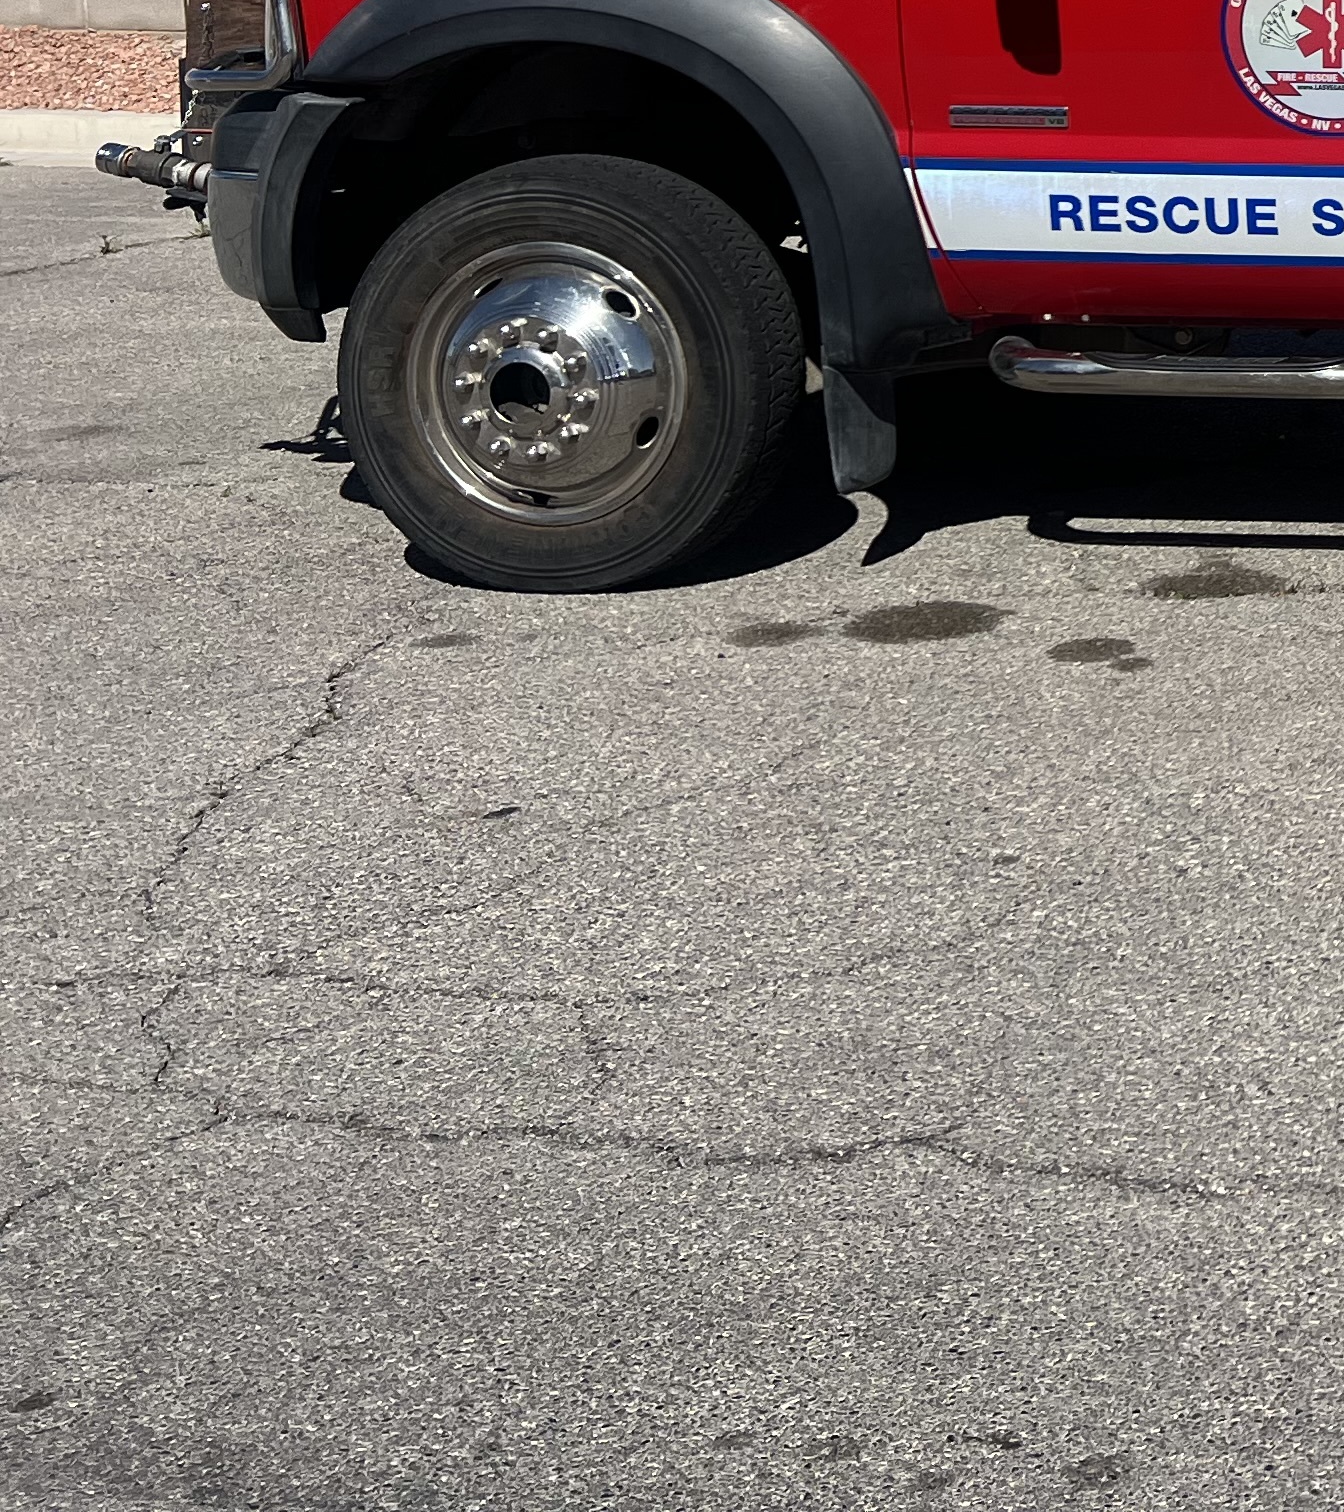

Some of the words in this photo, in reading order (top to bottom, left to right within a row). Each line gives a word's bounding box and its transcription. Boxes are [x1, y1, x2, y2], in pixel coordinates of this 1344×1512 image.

[1277, 73, 1296, 82] FIRE
[1304, 73, 1340, 83] RESCUE
[1239, 68, 1262, 94] LAS
[1258, 92, 1299, 123] VEGAS
[1311, 119, 1331, 131] NV
[1048, 193, 1279, 235] RESCUE
